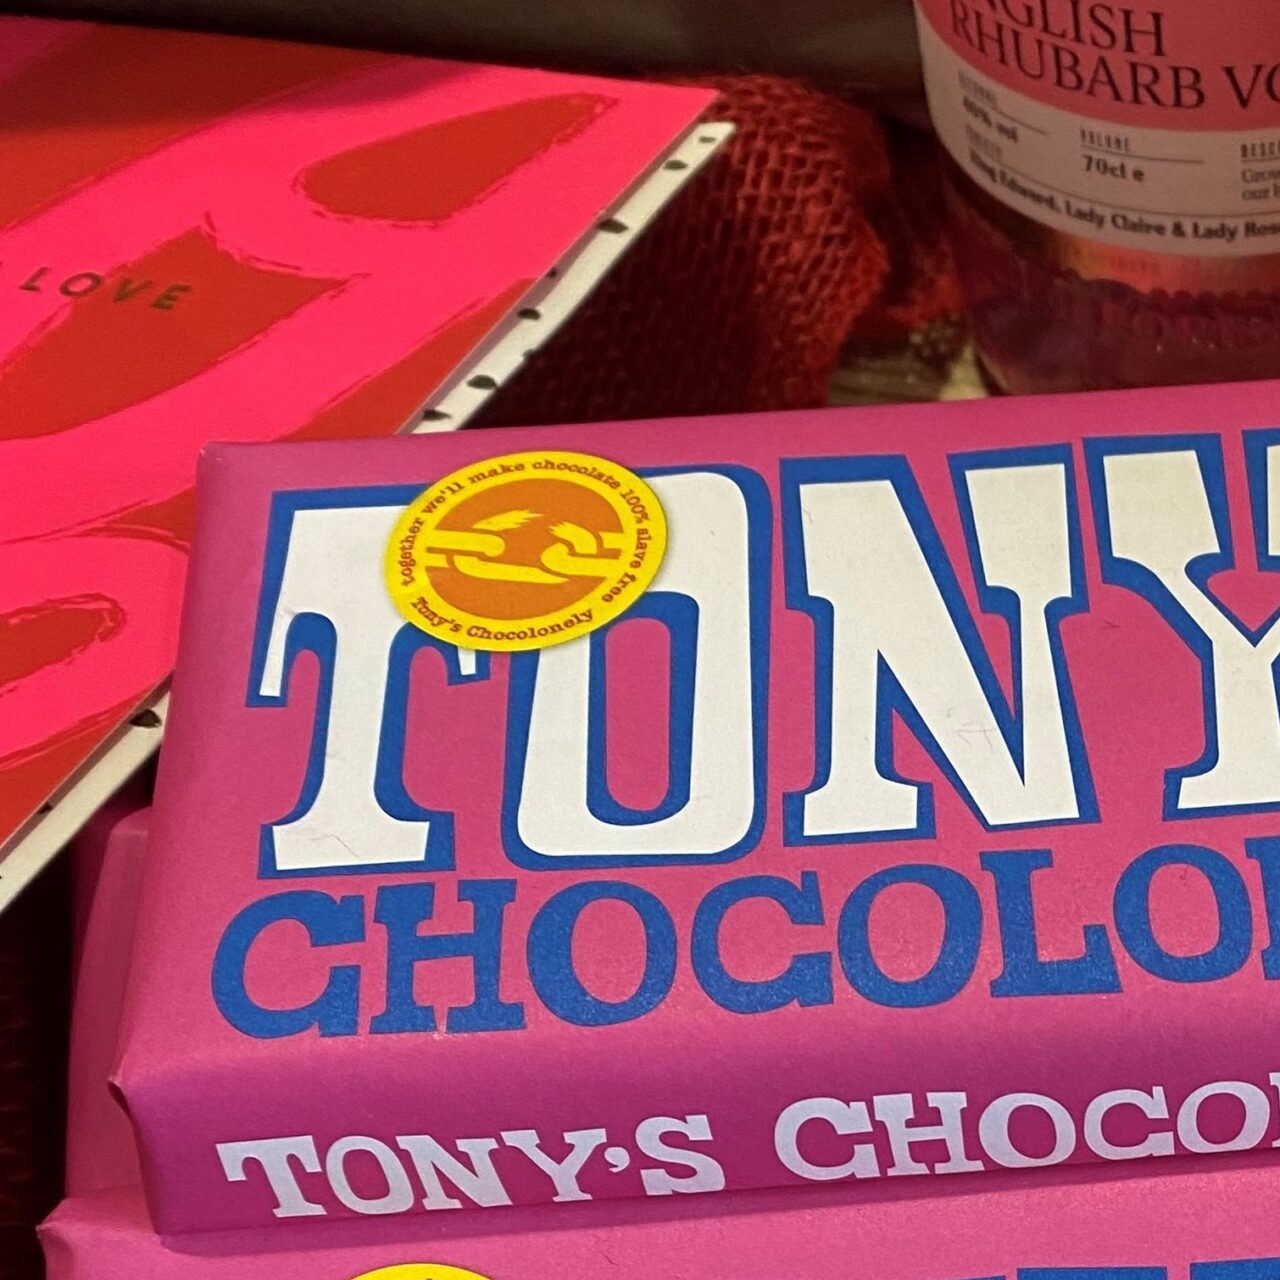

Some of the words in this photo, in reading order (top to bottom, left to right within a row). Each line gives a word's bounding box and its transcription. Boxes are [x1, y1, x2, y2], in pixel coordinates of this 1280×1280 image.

[985, 0, 1167, 56] GLISH
[950, 0, 1205, 109] RHUBARB
[1082, 154, 1126, 180] 70cl
[1065, 200, 1105, 228] Lady
[1111, 214, 1165, 236] Claire
[1171, 220, 1186, 238] &
[1192, 218, 1239, 242] Lady
[19, 265, 192, 310] LOVE
[468, 461, 526, 485] make
[531, 459, 622, 490] chocolate
[422, 483, 465, 515] we'll
[620, 489, 650, 524] 100%
[398, 517, 425, 588] together
[629, 527, 653, 570] slave
[601, 571, 638, 604] free
[411, 597, 463, 634] Tony's
[466, 608, 594, 642] Chocolonely
[215, 1114, 726, 1219] TONY'S
